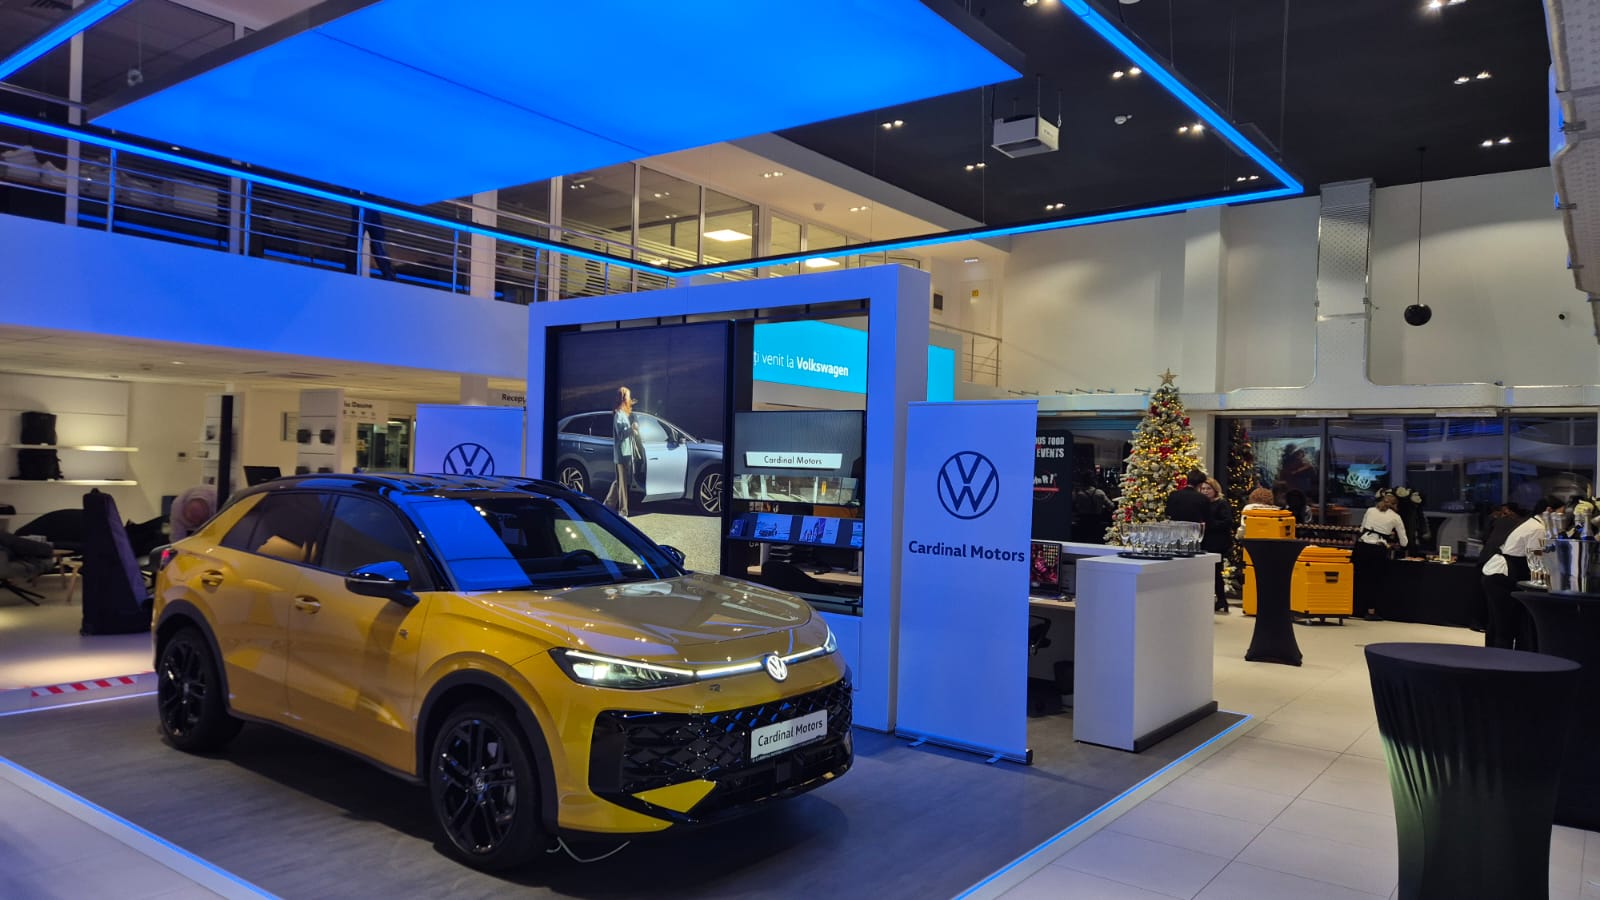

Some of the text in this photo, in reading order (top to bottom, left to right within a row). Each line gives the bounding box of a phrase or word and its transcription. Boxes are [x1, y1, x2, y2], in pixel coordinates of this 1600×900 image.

[762, 353, 785, 367] venit
[786, 355, 794, 369] la
[796, 356, 849, 378] Volkswagen
[1048, 436, 1065, 445] FOOD
[763, 455, 822, 465] Cardinal Motors
[1036, 447, 1065, 458] EVENTS
[937, 451, 1000, 520] VW
[908, 540, 1025, 562] Cardinal Motors
[766, 655, 788, 681] VW
[757, 720, 823, 747] Cardinal Motors
